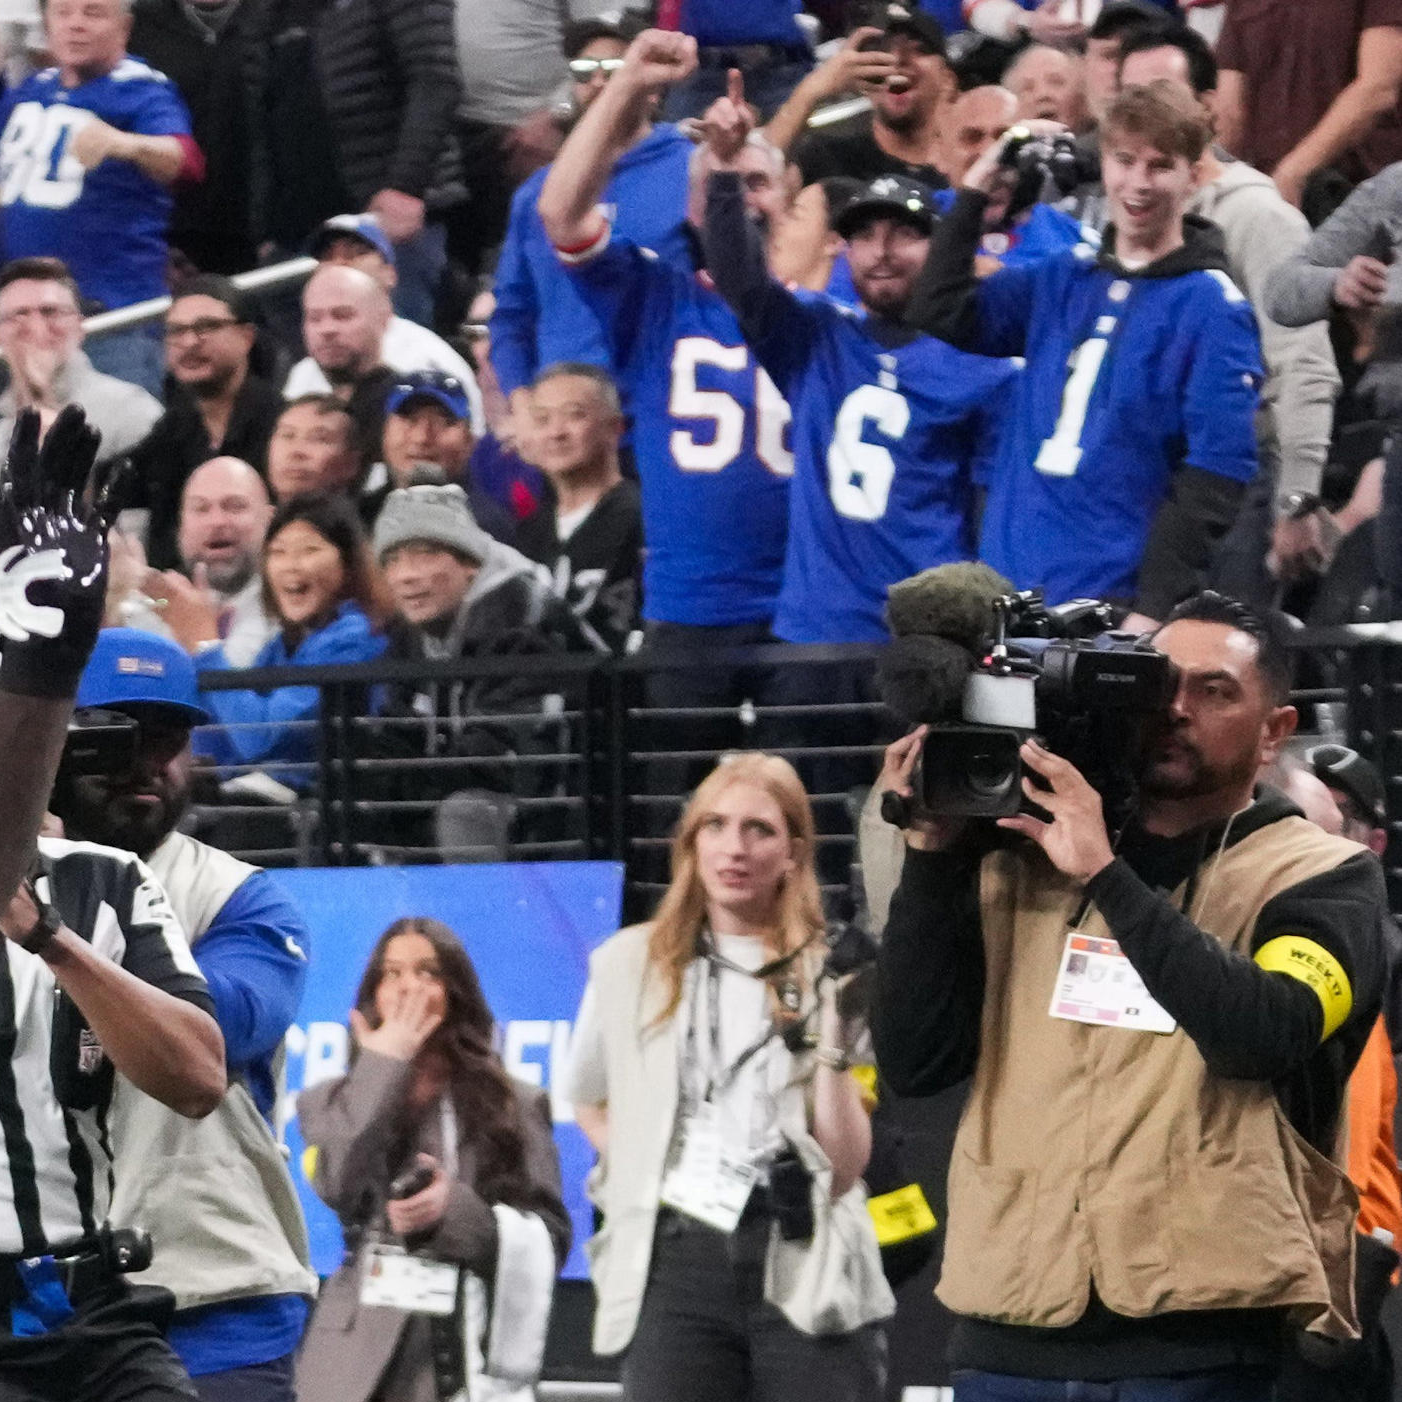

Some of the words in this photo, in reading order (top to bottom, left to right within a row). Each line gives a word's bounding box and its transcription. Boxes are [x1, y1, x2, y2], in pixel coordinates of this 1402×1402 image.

[827, 384, 910, 521] 6
[1034, 338, 1108, 476] 1
[1290, 948, 1335, 981] WEEK
